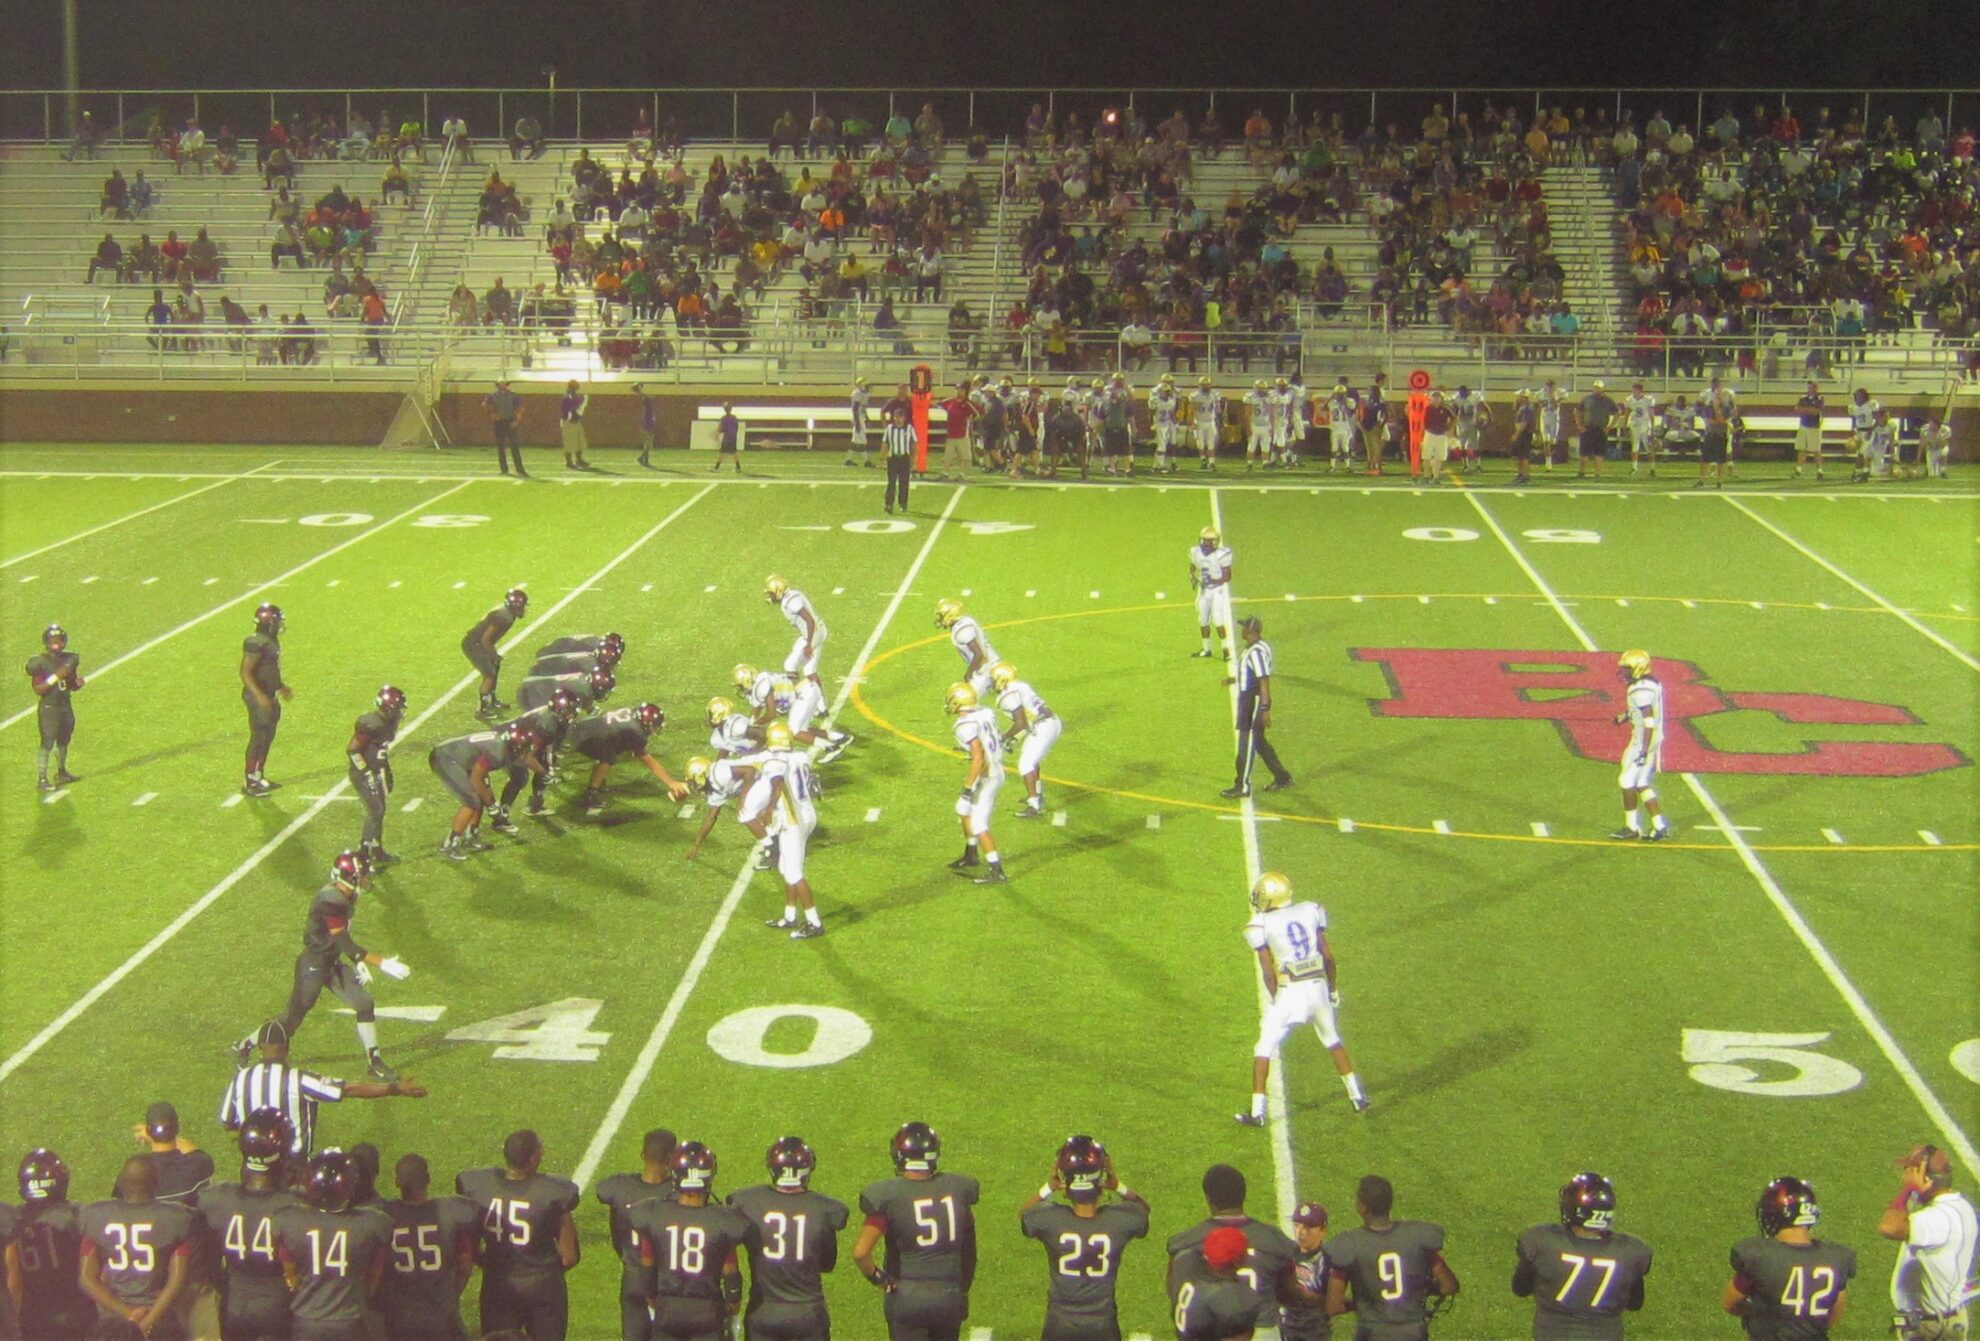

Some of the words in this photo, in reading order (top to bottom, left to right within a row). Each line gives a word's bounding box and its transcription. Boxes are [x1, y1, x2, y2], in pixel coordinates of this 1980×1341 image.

[1287, 921, 1310, 961] 9
[225, 1214, 274, 1261] 44
[484, 1198, 531, 1246] 45
[763, 1211, 806, 1261] 31
[914, 1196, 956, 1247] 51
[104, 1222, 155, 1272] 35
[306, 1229, 348, 1277] 14
[391, 1224, 442, 1273] 55
[666, 1225, 705, 1274] 18
[1059, 1232, 1111, 1278] 23
[1378, 1252, 1402, 1301] 9
[1556, 1253, 1616, 1307] 77
[1781, 1266, 1834, 1317] 42
